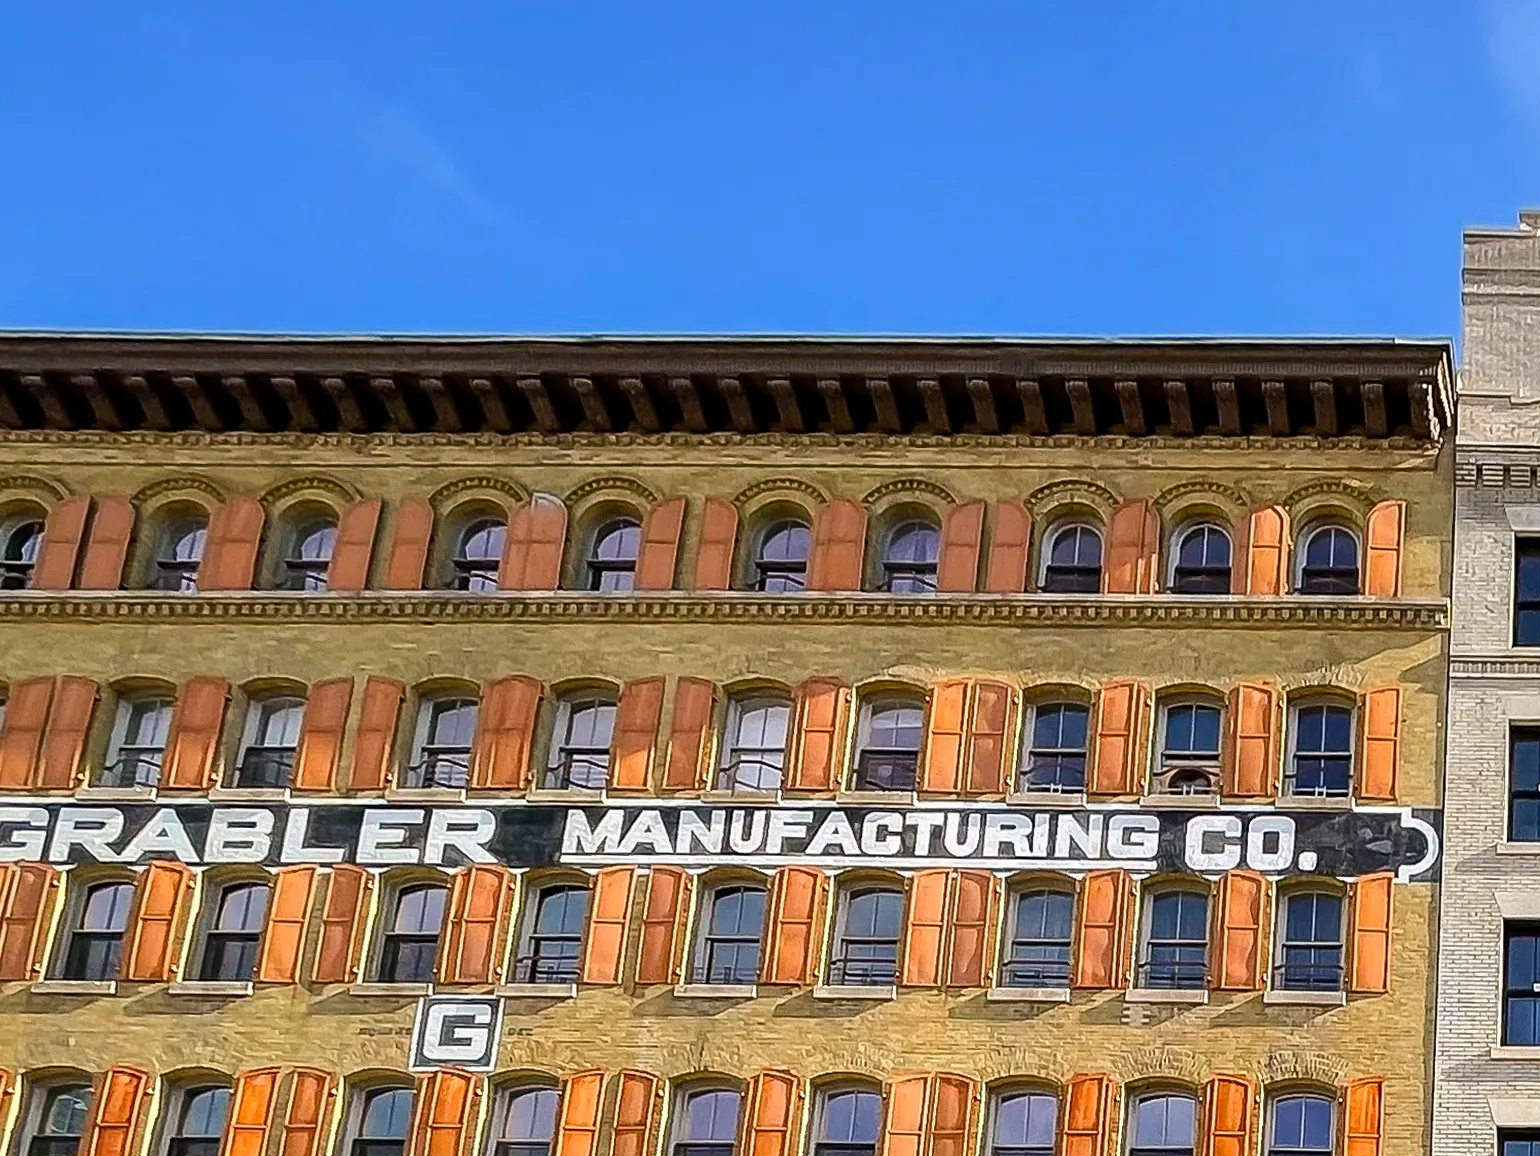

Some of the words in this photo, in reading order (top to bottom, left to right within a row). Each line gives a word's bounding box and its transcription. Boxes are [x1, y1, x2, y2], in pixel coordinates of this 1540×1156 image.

[0, 808, 499, 863] GRABLER
[560, 810, 1158, 859] MANUFACTURING
[1185, 816, 1318, 871] CO.
[423, 1004, 492, 1060] G
